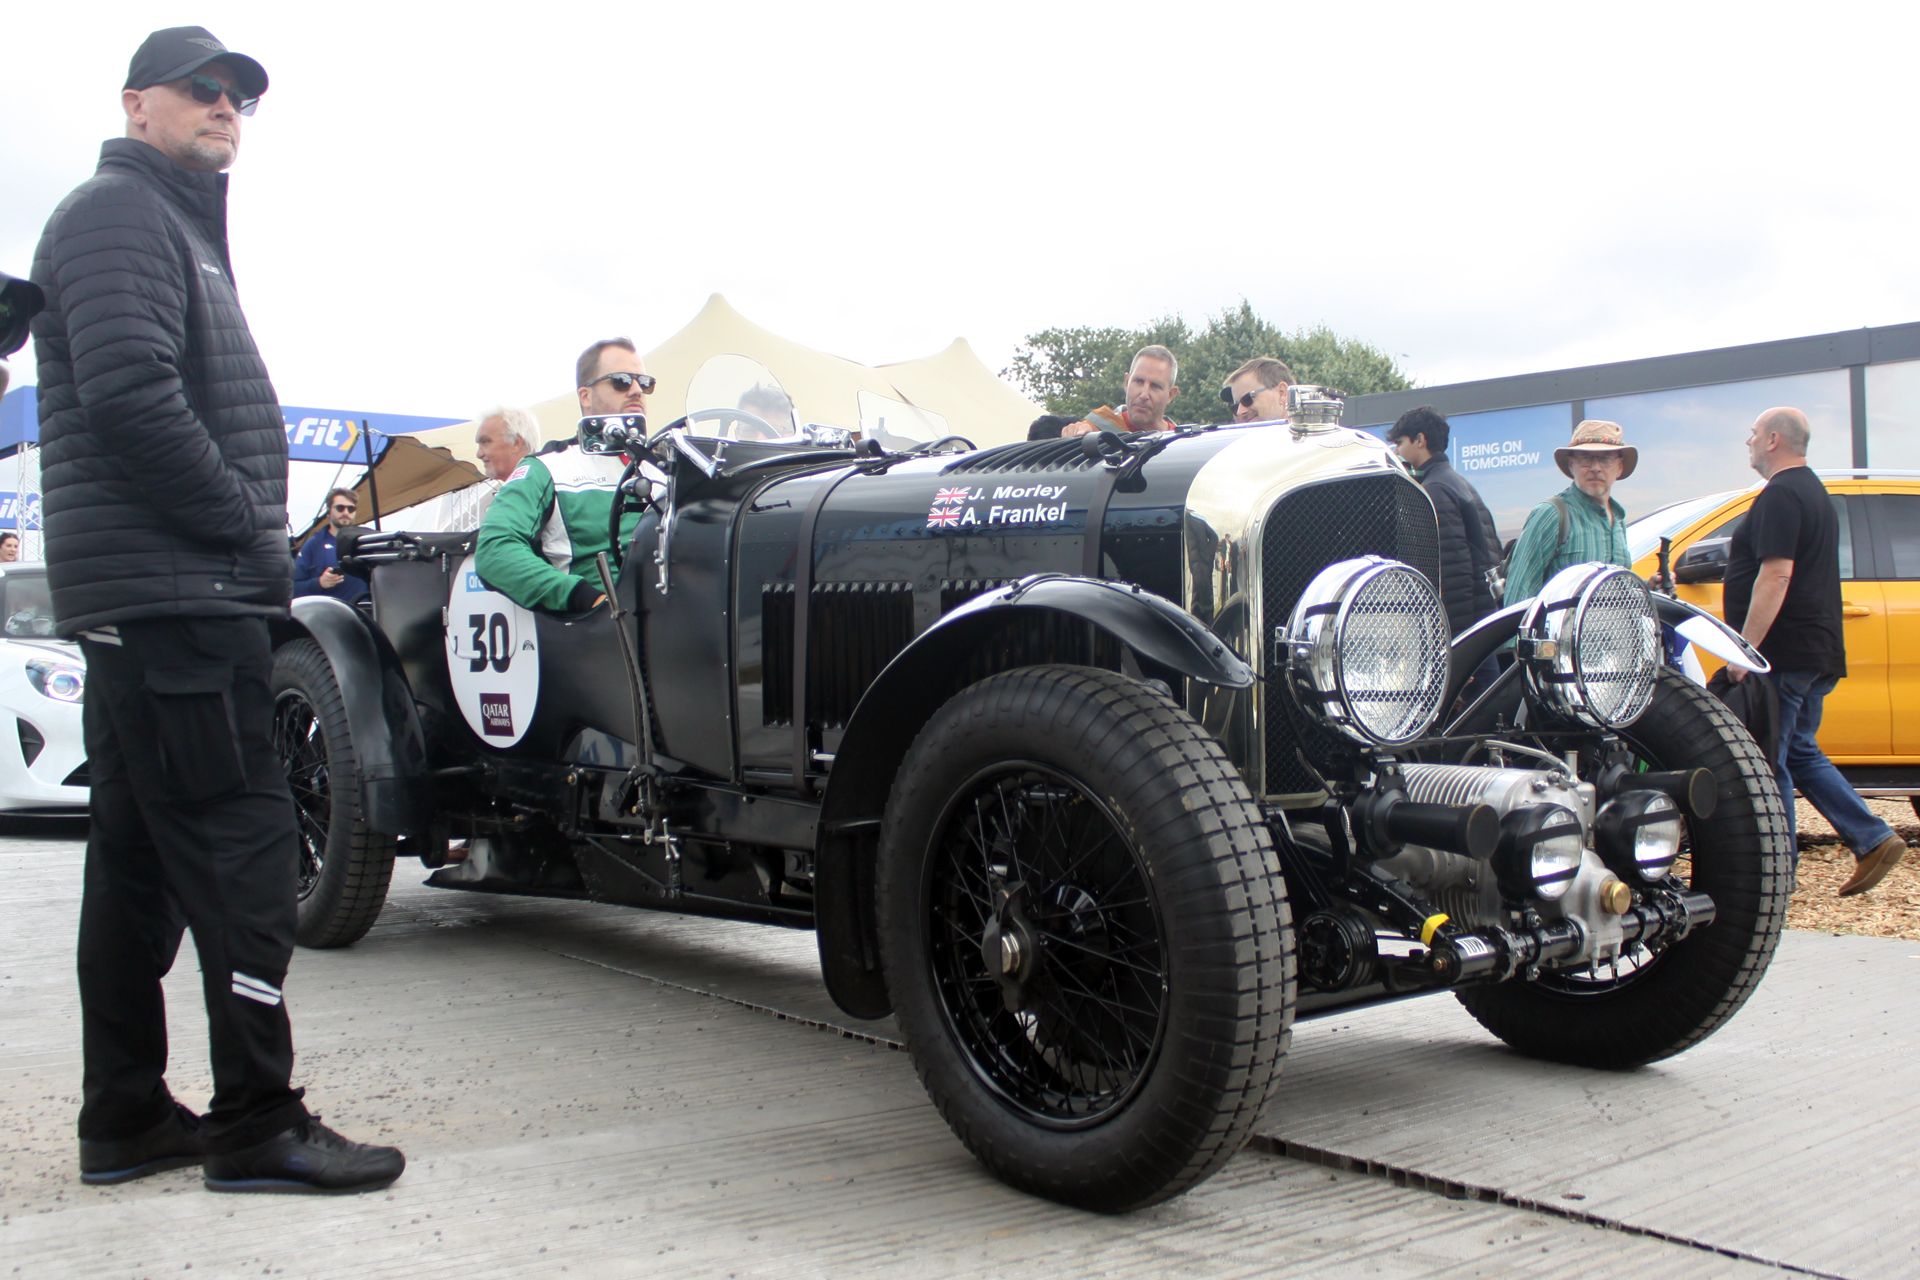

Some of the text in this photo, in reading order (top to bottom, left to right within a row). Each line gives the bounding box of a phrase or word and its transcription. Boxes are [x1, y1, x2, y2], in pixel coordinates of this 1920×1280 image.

[1462, 439, 1522, 458] BRING ON
[1462, 451, 1540, 471] TOMORROW
[968, 484, 1067, 500] J. Morley
[960, 501, 1068, 525] A. Frankel
[469, 612, 510, 673] 30
[482, 702, 510, 718] QATAR
[490, 717, 511, 727] AIRWAYS
